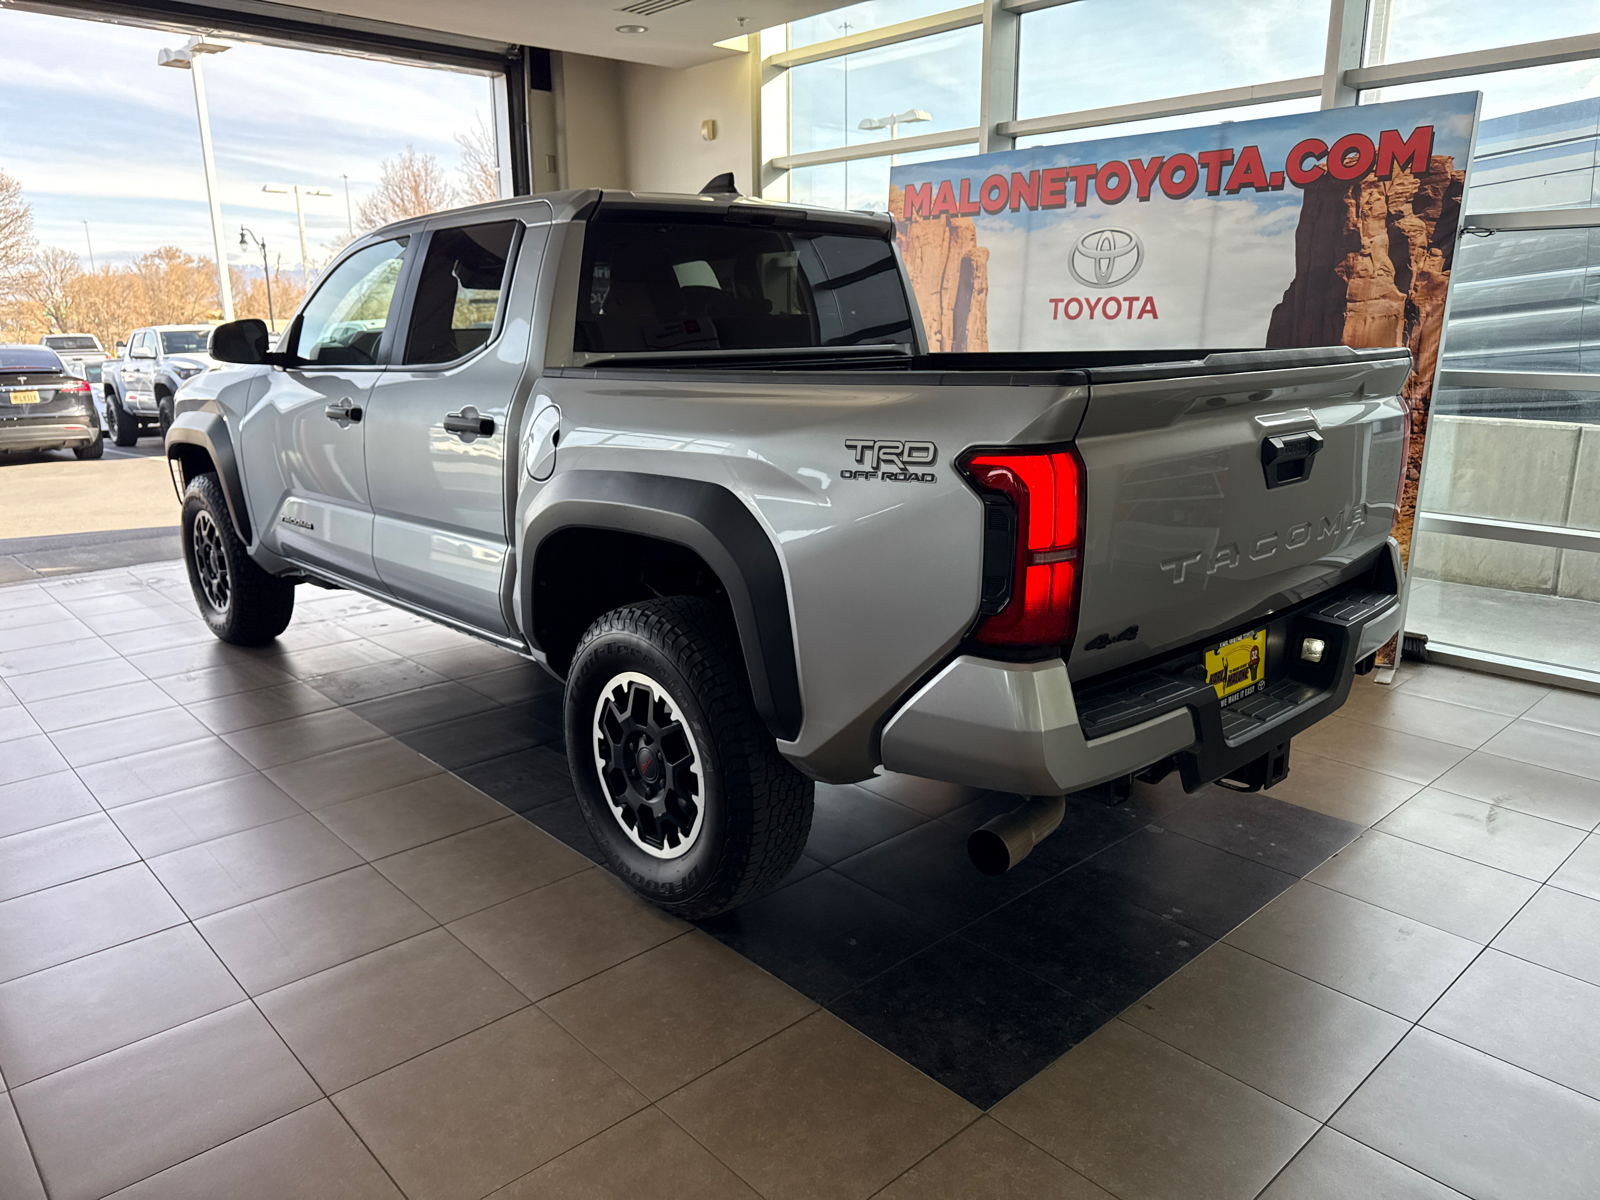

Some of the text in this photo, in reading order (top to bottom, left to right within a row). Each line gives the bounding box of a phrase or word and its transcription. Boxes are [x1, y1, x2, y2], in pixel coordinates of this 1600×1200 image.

[903, 125, 1434, 222] MALONETOYOTA.COM
[1049, 296, 1159, 320] TOYOTA
[845, 439, 938, 471] TRD
[840, 470, 937, 484] OFF ROAD
[1160, 503, 1367, 584] TACOMA
[1251, 650, 1258, 660] 32
[1221, 686, 1255, 707] WE MAKE IT EASY
